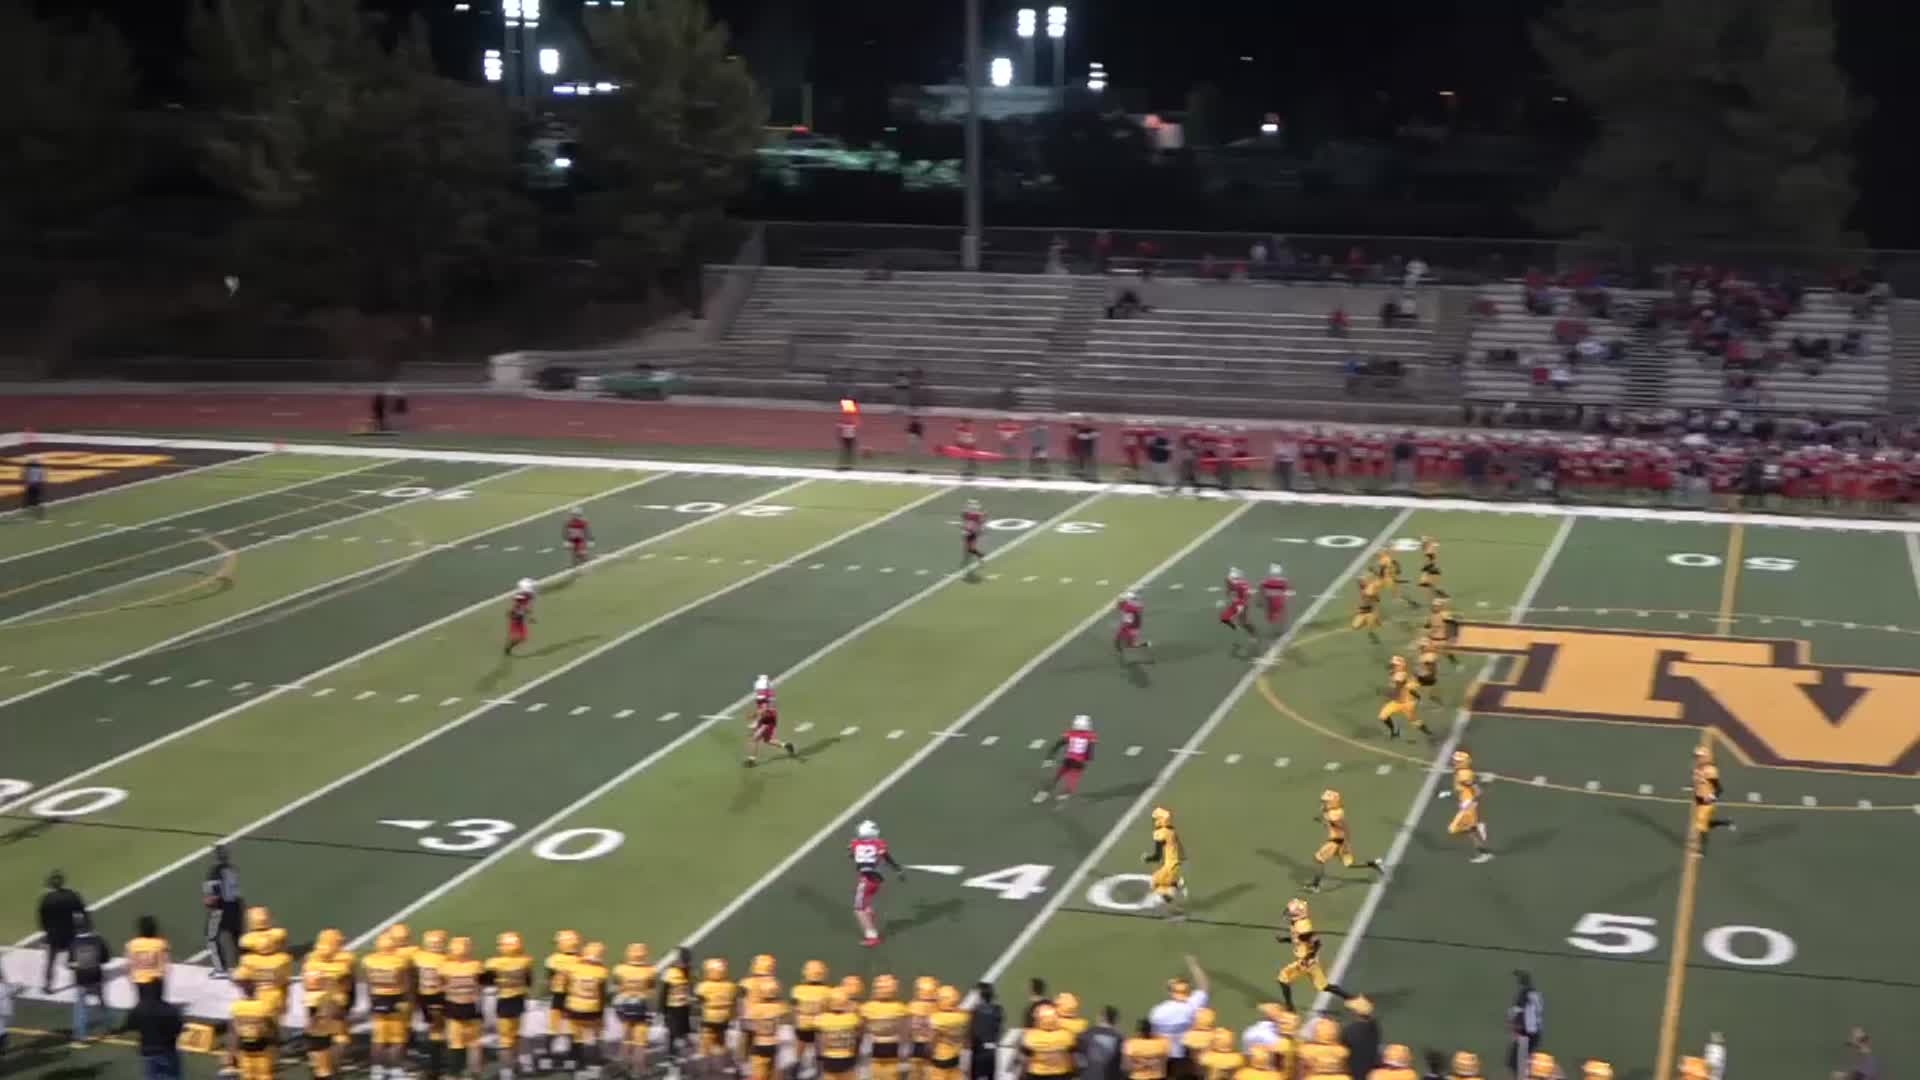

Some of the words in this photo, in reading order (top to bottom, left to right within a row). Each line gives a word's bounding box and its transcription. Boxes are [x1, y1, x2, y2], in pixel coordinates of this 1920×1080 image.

[418, 818, 624, 860] 30
[960, 863, 1166, 910] 40
[1565, 912, 1796, 966] 50
